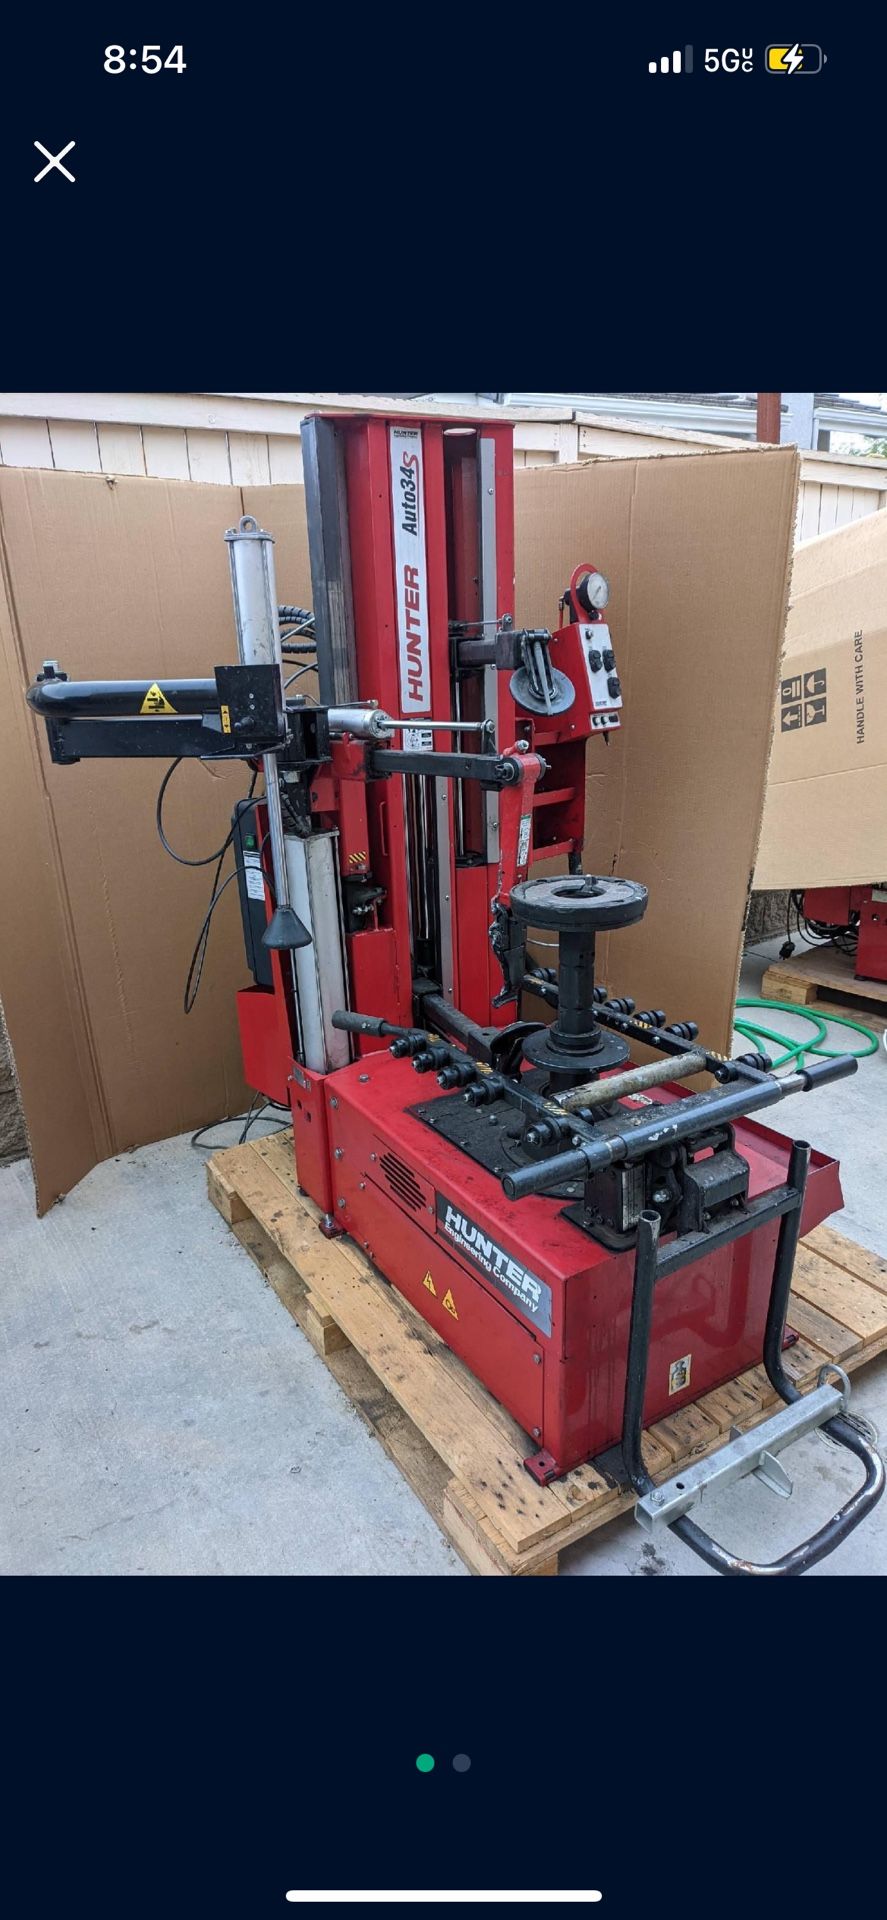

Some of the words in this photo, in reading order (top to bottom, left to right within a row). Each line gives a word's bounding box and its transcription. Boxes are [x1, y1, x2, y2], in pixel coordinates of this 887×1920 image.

[404, 564, 424, 702] HUNTER
[854, 629, 863, 662] CARE
[855, 664, 864, 695] WITH
[856, 697, 865, 745] HANDLE
[444, 1221, 492, 1273] Engineering
[493, 1266, 539, 1313] Company
[445, 1205, 542, 1303] HUNTER
